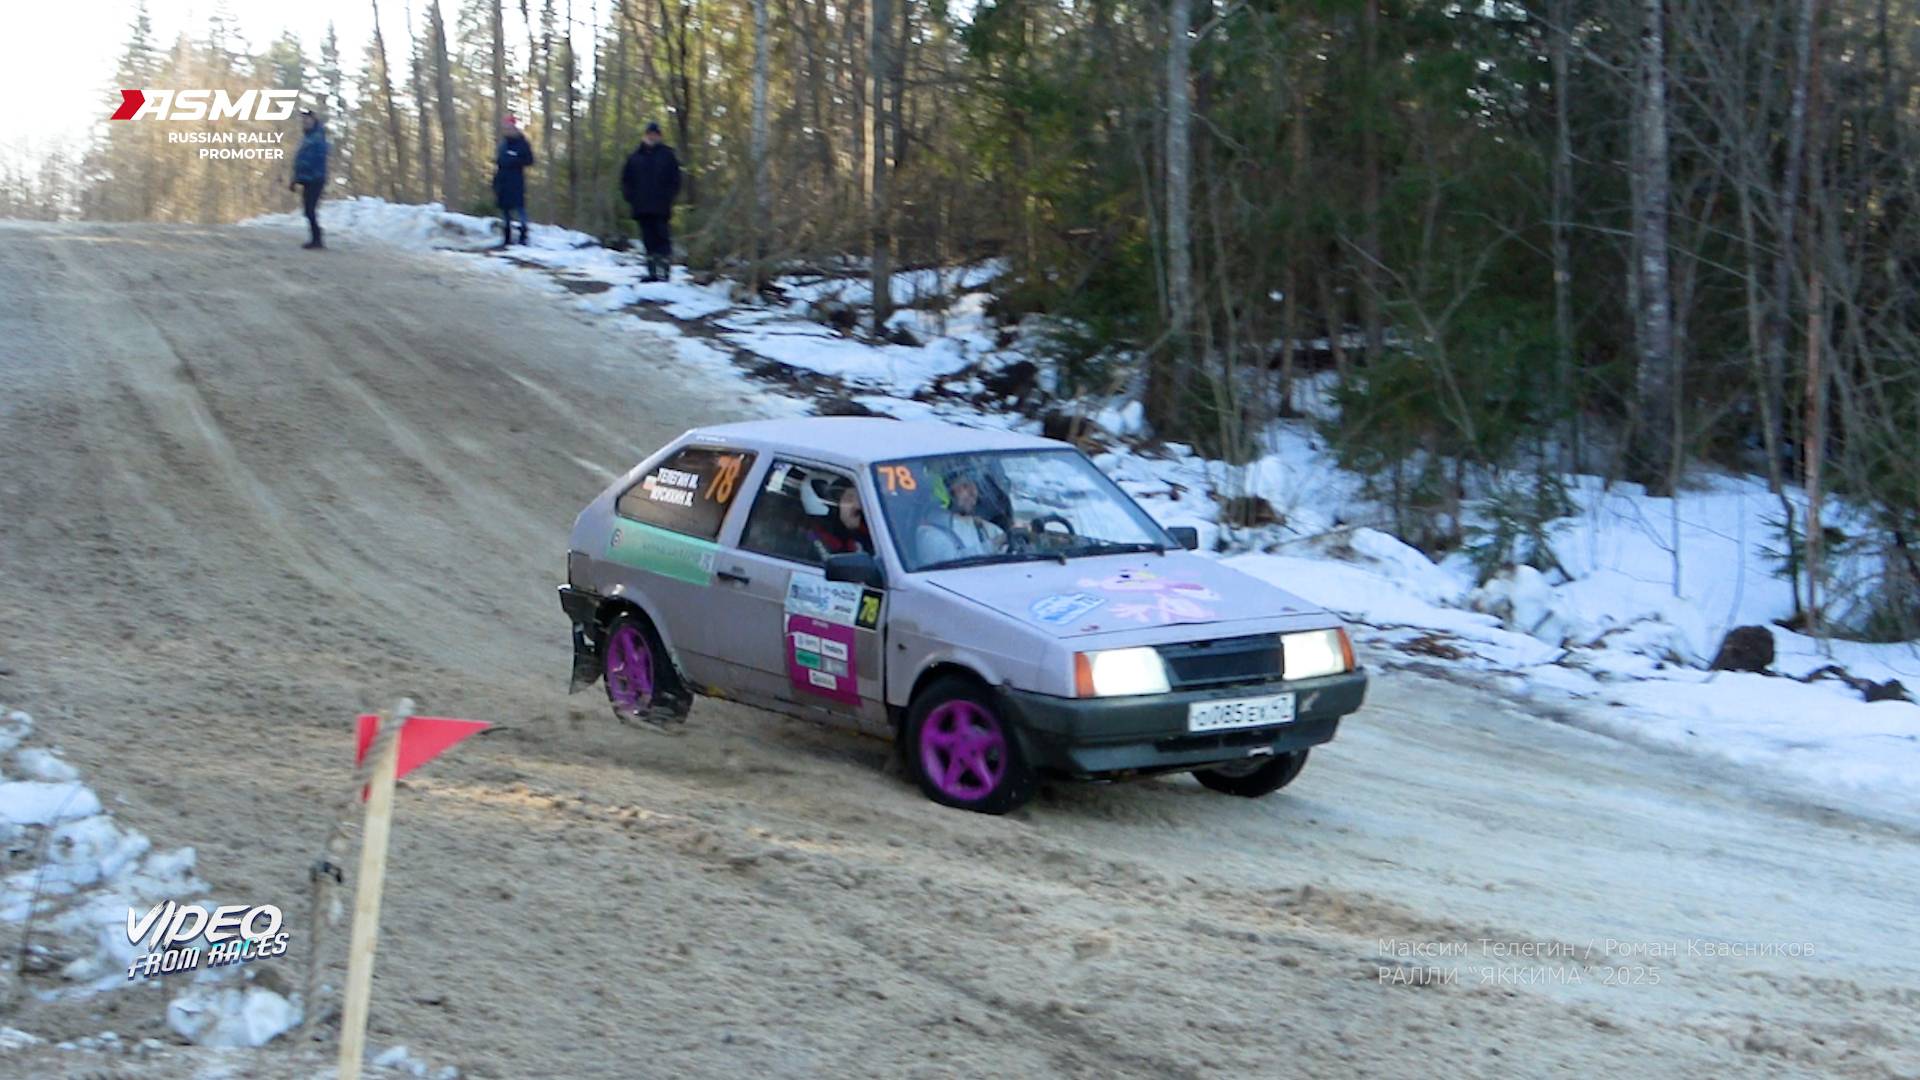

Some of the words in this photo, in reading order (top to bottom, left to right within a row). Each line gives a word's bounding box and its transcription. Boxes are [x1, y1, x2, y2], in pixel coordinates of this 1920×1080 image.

[704, 455, 742, 504] 78
[877, 465, 917, 493] 78
[859, 595, 880, 624] 78
